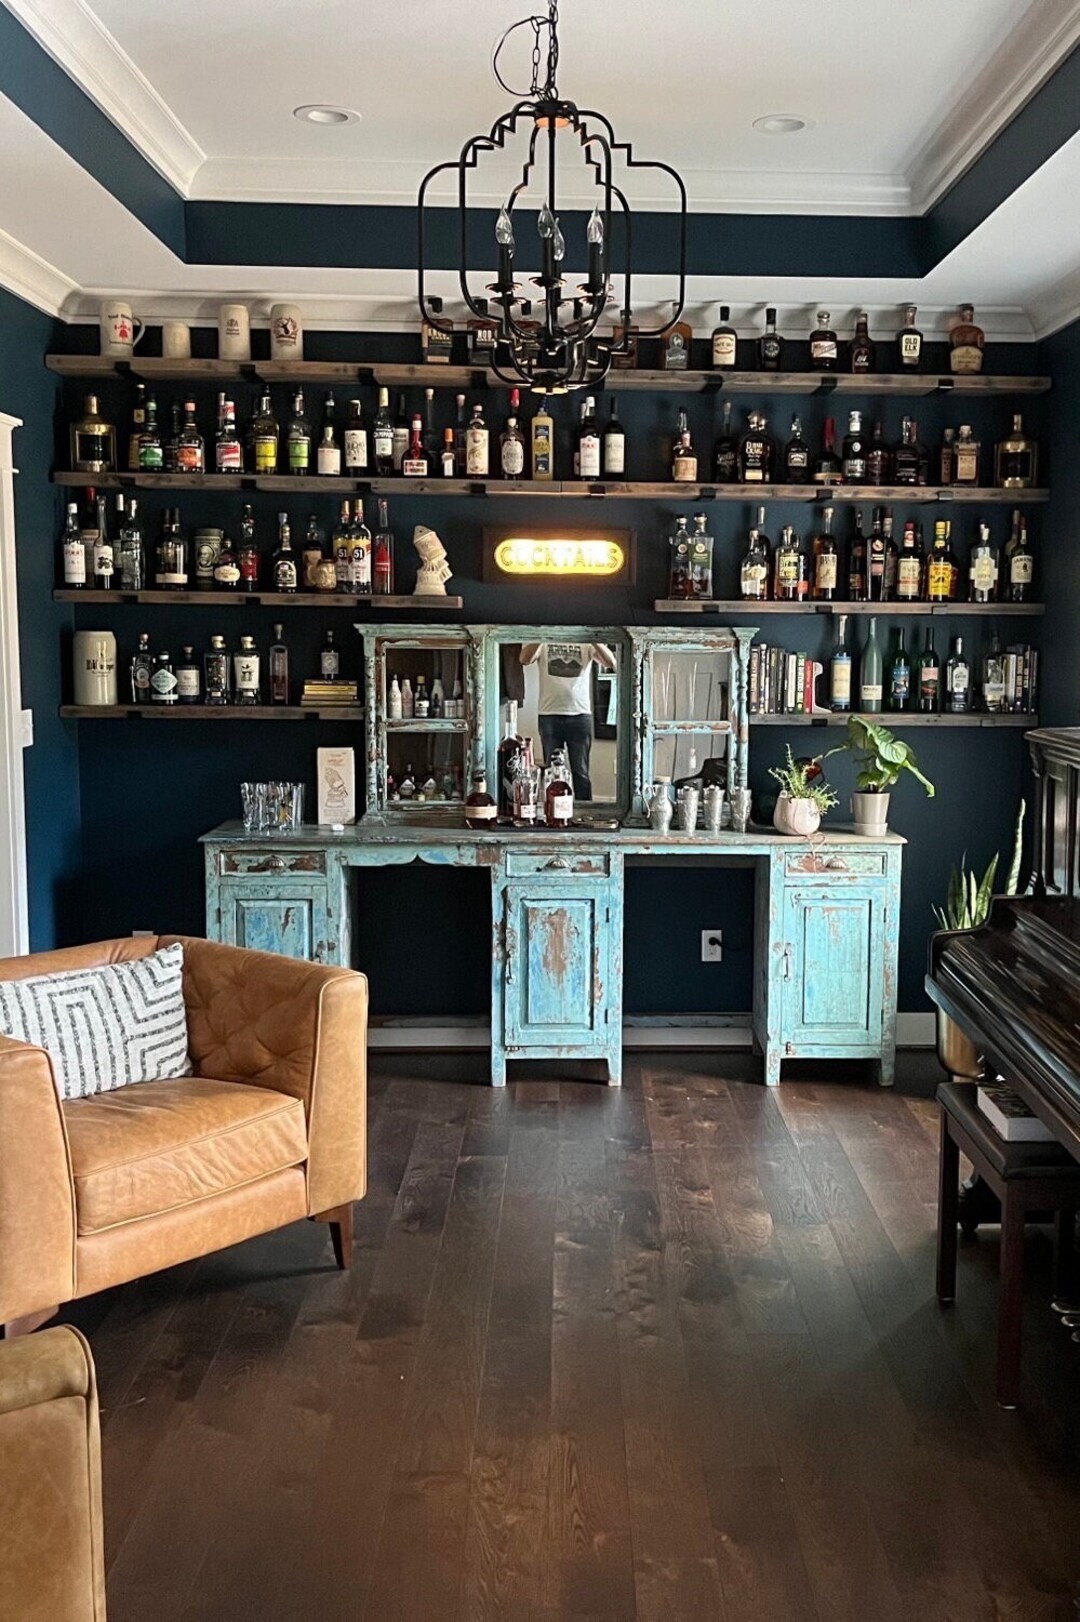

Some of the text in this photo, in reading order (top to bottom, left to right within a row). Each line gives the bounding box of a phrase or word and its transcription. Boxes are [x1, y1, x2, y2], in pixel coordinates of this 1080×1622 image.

[904, 337, 918, 345] OLD
[338, 548, 348, 558] 51
[353, 549, 364, 559] 51
[500, 546, 618, 568] COCKTAILS
